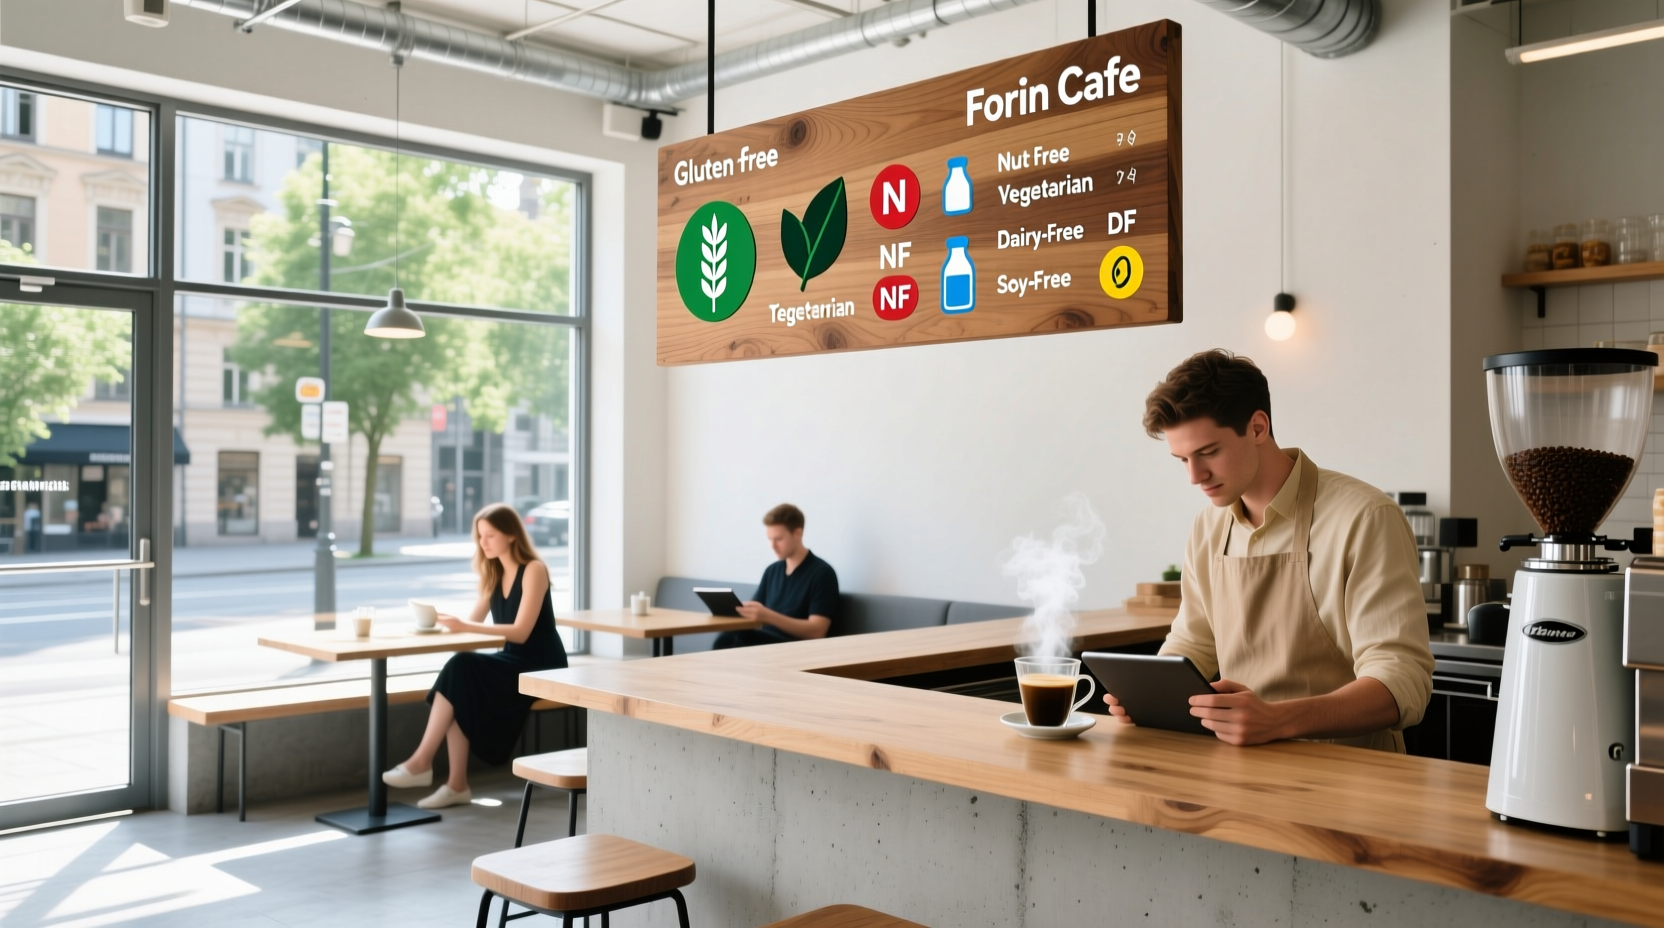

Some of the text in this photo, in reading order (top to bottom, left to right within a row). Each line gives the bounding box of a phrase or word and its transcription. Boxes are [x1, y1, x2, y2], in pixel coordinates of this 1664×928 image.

[966, 55, 1141, 127] Forin Cafe
[674, 145, 779, 186] Gluten free
[997, 146, 1070, 173] Nut Free
[882, 179, 906, 215] N
[997, 174, 1094, 208] Vegetarian
[1108, 209, 1137, 235] DF
[997, 223, 1085, 251] Dairy-Free
[880, 241, 912, 270] NF
[880, 284, 911, 311] NF
[996, 270, 1072, 298] Soy-Free
